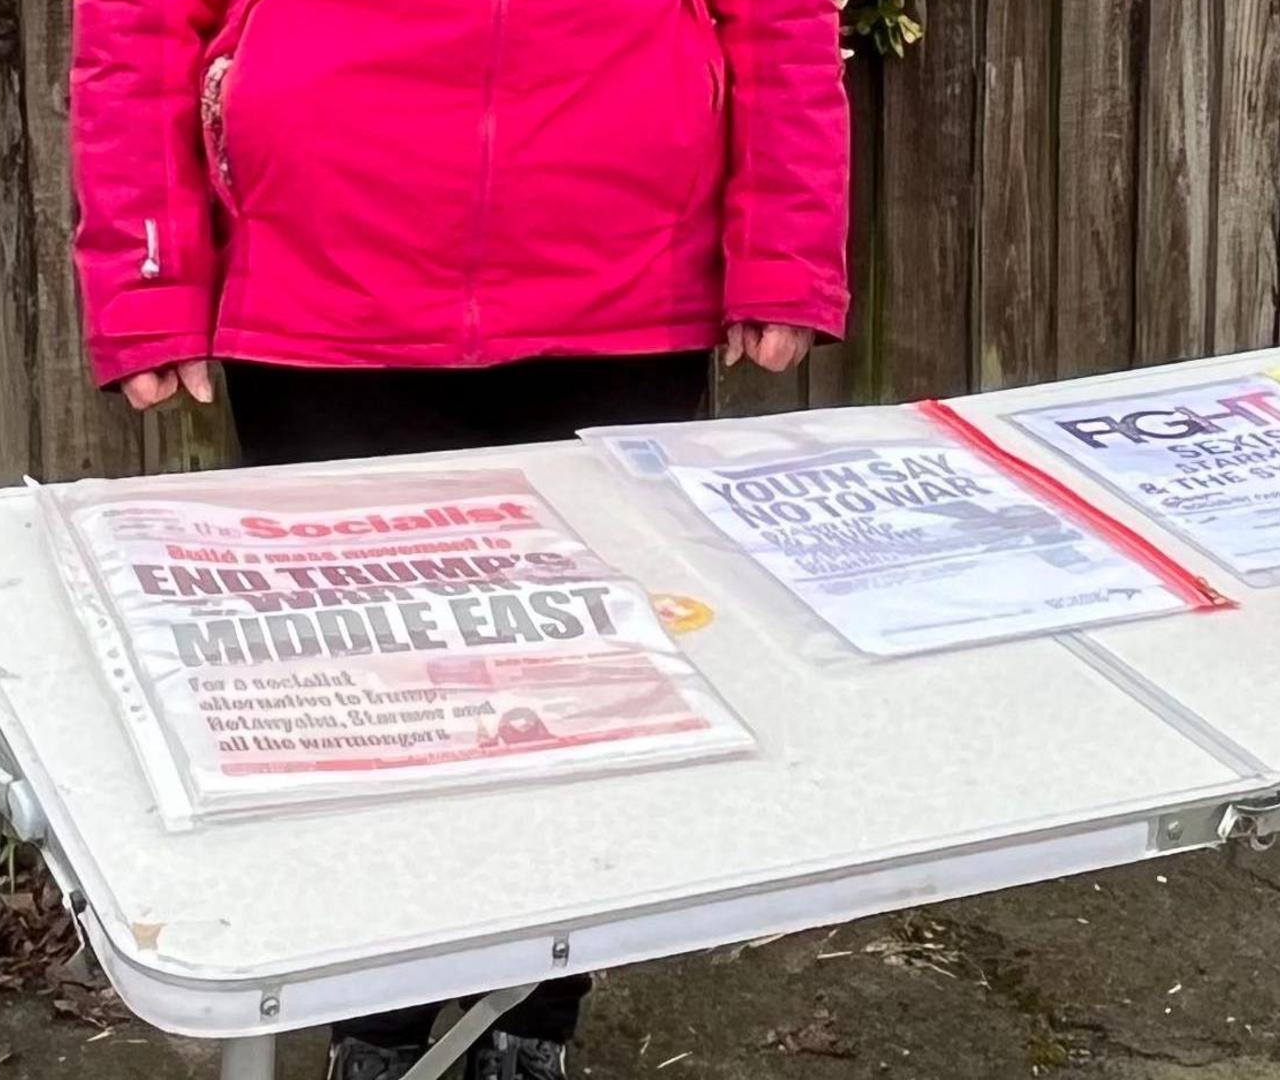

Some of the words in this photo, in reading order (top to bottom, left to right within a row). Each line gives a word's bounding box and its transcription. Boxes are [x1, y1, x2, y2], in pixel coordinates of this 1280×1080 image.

[702, 465, 869, 505] YOUTH
[868, 453, 957, 484] SAY
[1138, 482, 1170, 496] &
[1170, 469, 1249, 491] THE
[730, 500, 812, 529] NO
[804, 490, 876, 517] TO
[869, 476, 995, 508] WAR
[239, 501, 534, 539] Socialist
[165, 544, 239, 564] Build
[244, 553, 261, 564] a
[264, 551, 339, 564] mass
[341, 537, 478, 560] movement
[482, 536, 512, 550] to
[131, 563, 272, 597] END
[273, 551, 578, 593] TRUMP'S
[170, 602, 448, 668] MIDDLE
[448, 587, 618, 648] EAST
[188, 676, 226, 693] For
[233, 678, 248, 691] a
[252, 671, 356, 691] socialist
[199, 693, 332, 712] alternative
[335, 692, 361, 706] to
[347, 708, 445, 727] Starmer
[452, 700, 496, 719] and
[219, 736, 250, 753] all
[252, 736, 297, 752] the
[298, 728, 450, 750] warmongers
